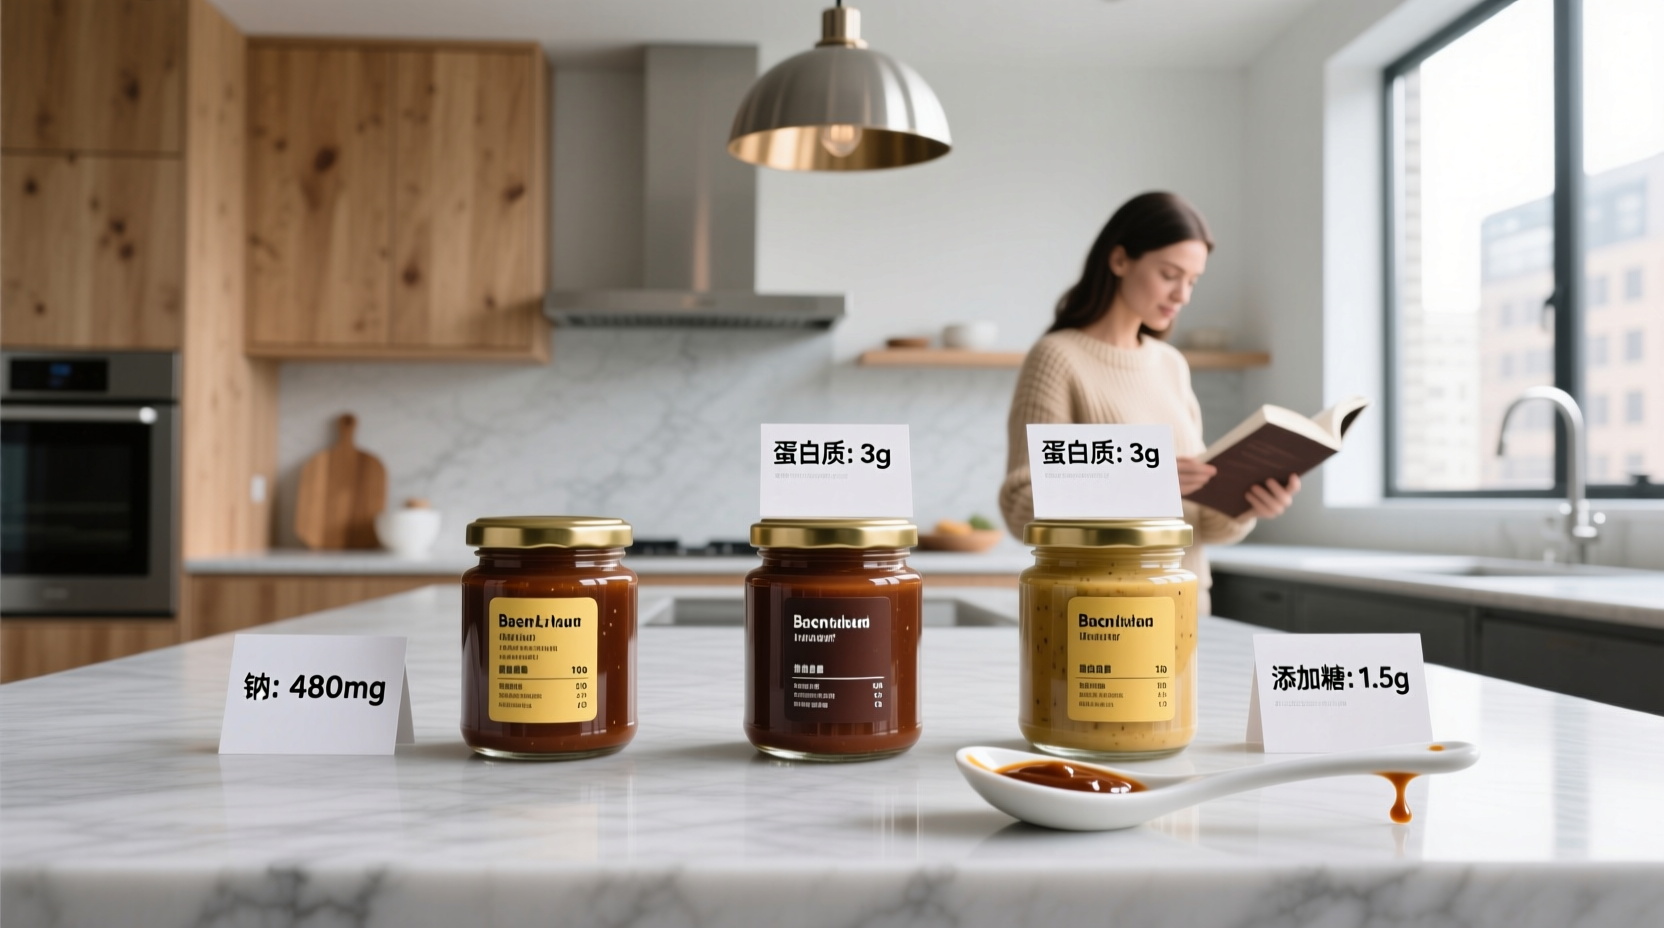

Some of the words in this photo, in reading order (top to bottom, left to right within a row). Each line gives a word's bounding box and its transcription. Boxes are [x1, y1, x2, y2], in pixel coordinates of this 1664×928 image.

[860, 443, 891, 469] 3g
[1129, 442, 1160, 469] 3g
[288, 674, 386, 706] 480mg
[1358, 665, 1410, 696] 1.5g
